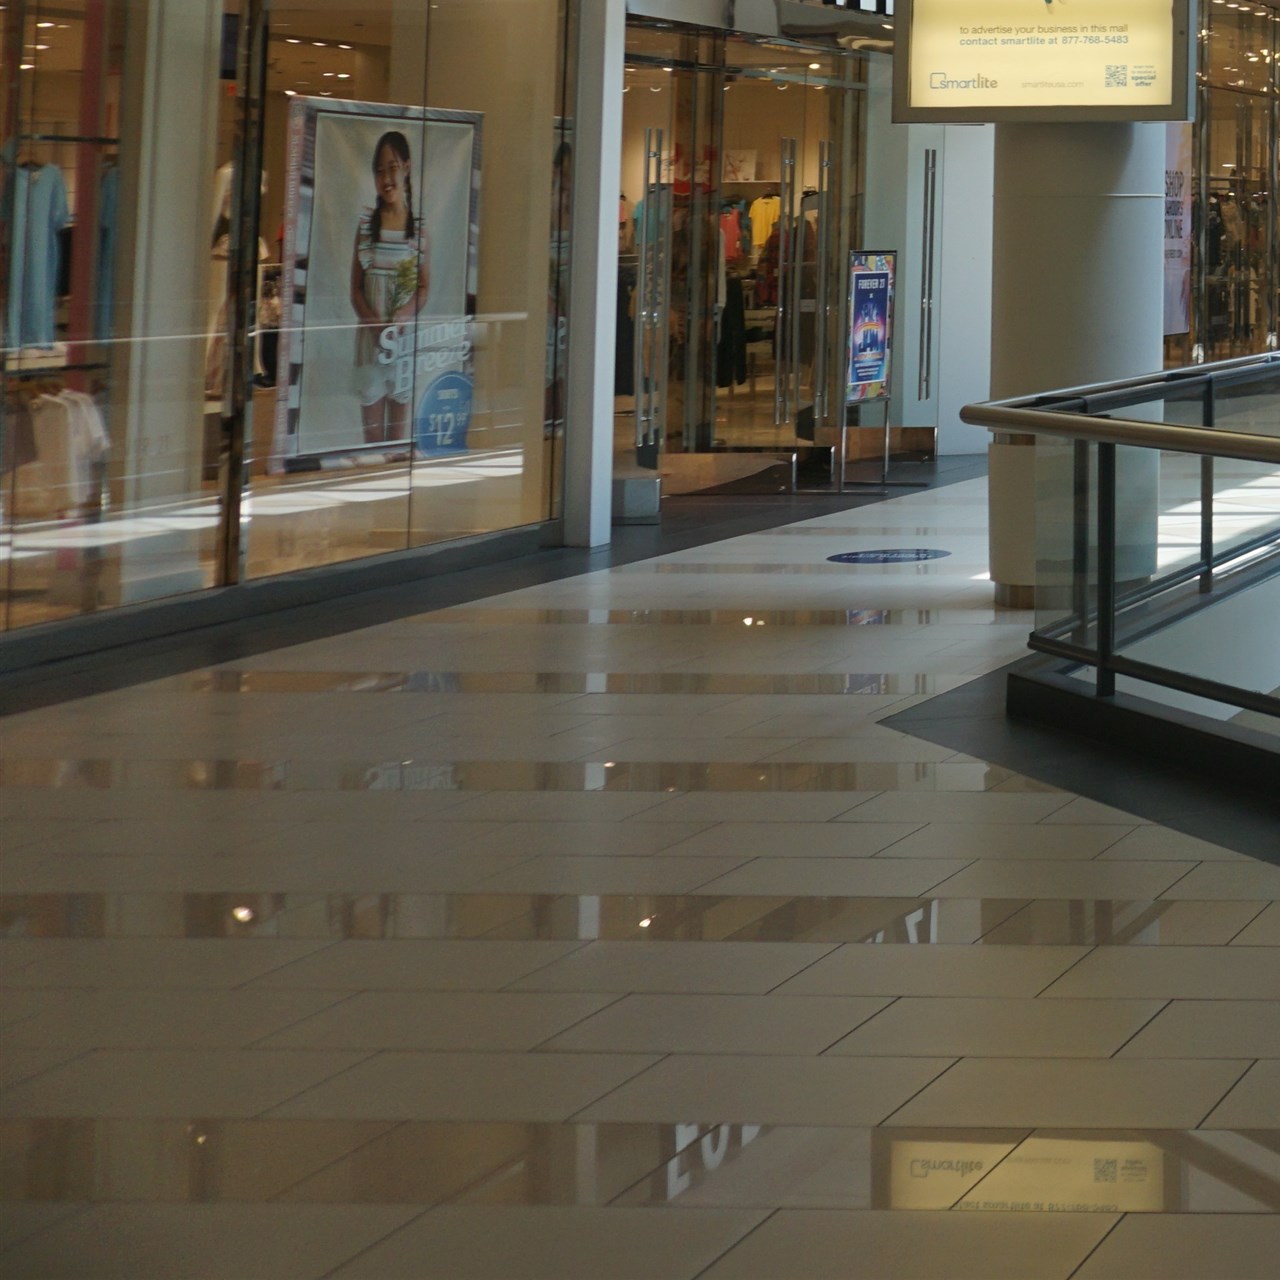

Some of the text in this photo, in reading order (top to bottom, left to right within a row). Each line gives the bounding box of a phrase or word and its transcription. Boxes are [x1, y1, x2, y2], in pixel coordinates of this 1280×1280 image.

[960, 23, 1128, 36] to advertise your business in this mall
[960, 35, 1129, 46] contact smartlite at 877-768-5483
[938, 72, 998, 89] smartlite
[1131, 74, 1157, 82] special
[378, 314, 473, 365] Summer
[391, 341, 472, 398] Breeze
